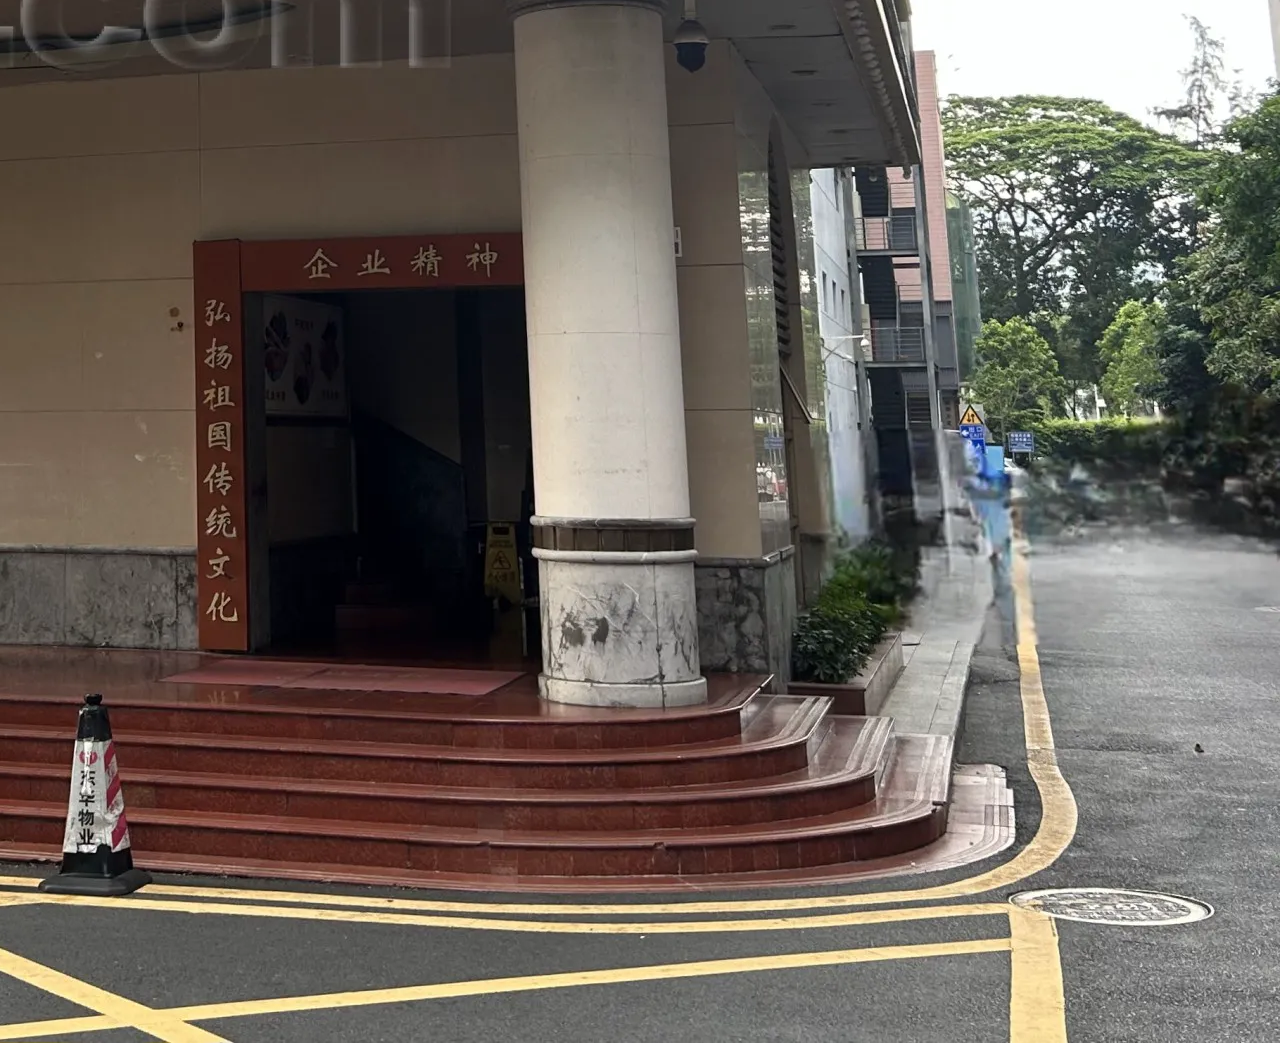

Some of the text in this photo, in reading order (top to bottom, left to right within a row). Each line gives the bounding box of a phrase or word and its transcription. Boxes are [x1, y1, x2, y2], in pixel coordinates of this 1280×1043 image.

[303, 242, 499, 279] 企业精神
[203, 299, 239, 623] 弘扬祖国传统文化
